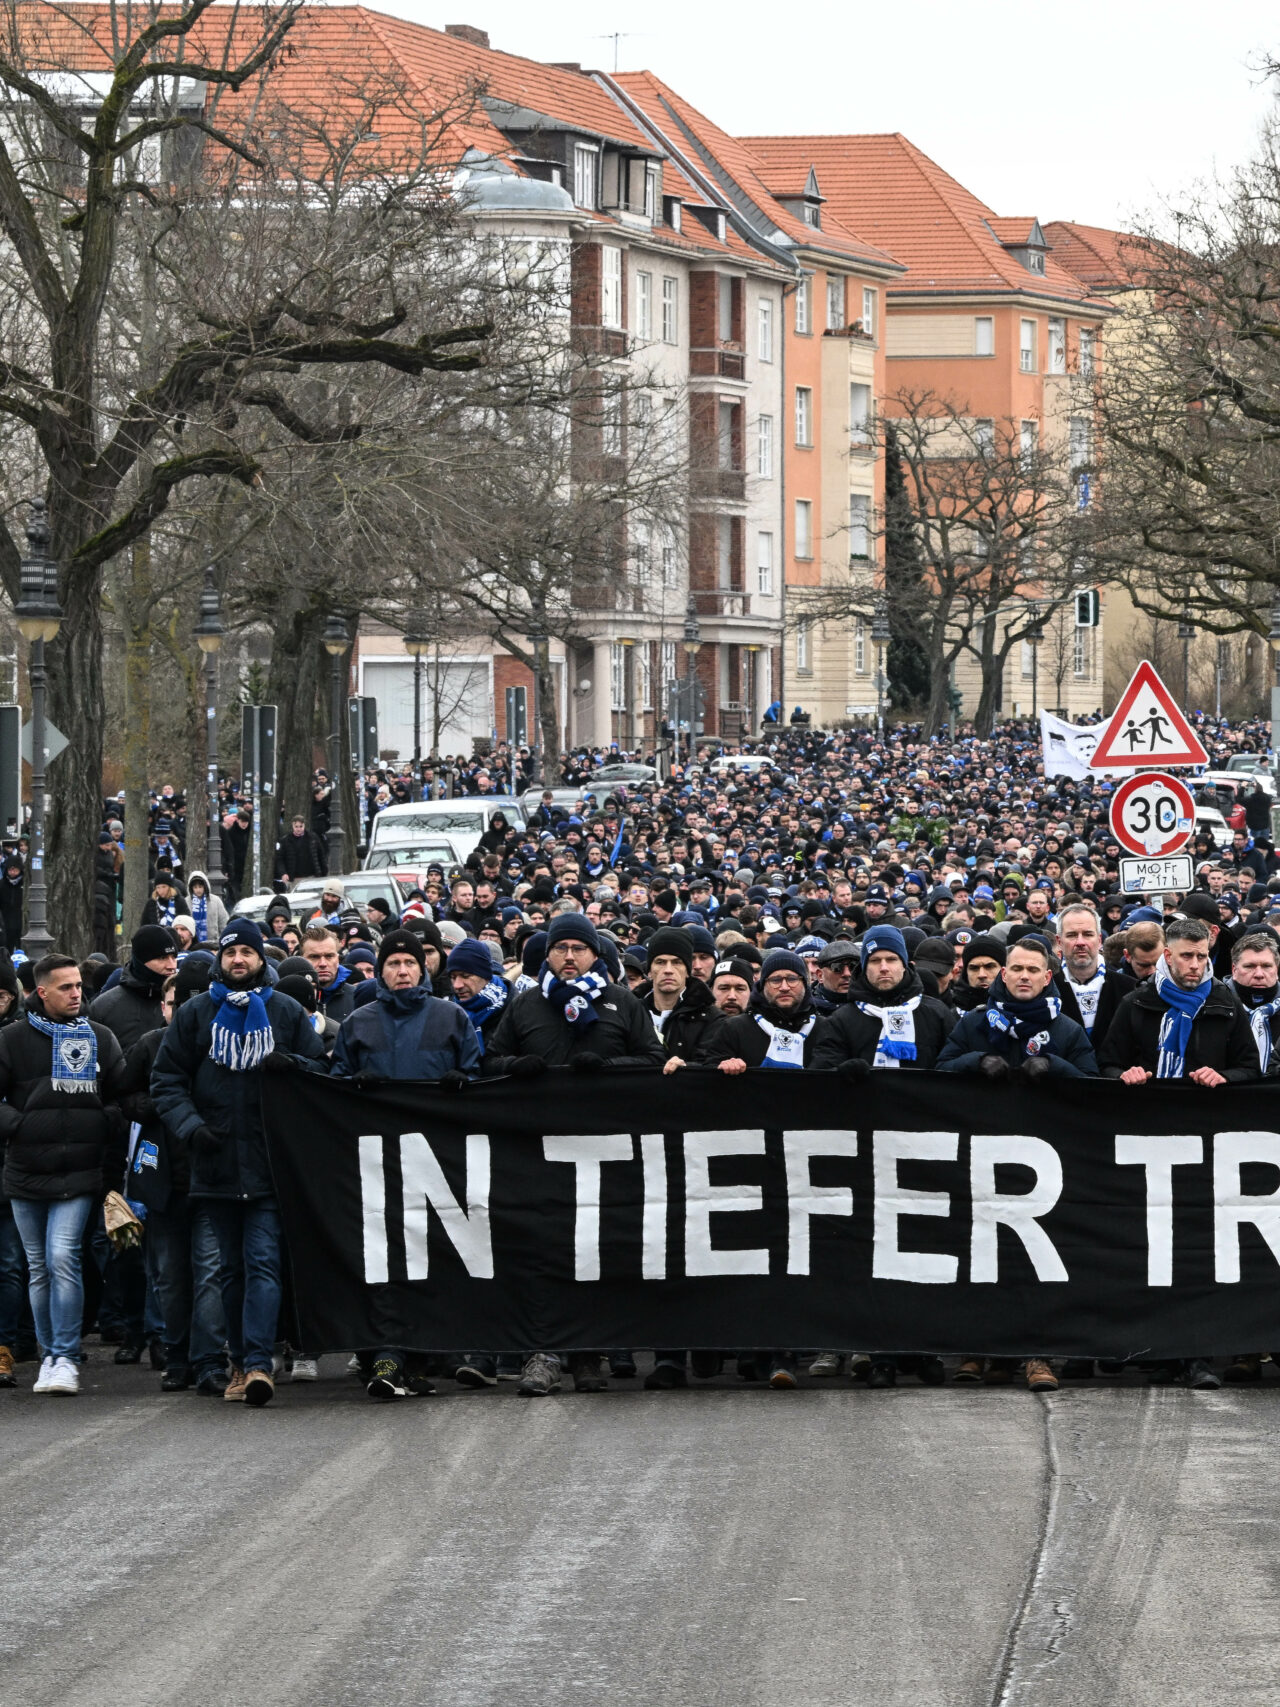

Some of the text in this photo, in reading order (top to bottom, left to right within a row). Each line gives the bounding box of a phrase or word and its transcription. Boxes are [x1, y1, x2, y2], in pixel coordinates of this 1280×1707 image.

[1130, 797, 1176, 833] 30
[1164, 862, 1177, 873] Fr
[359, 1133, 494, 1283] IN
[543, 1130, 1069, 1283] TIEFER
